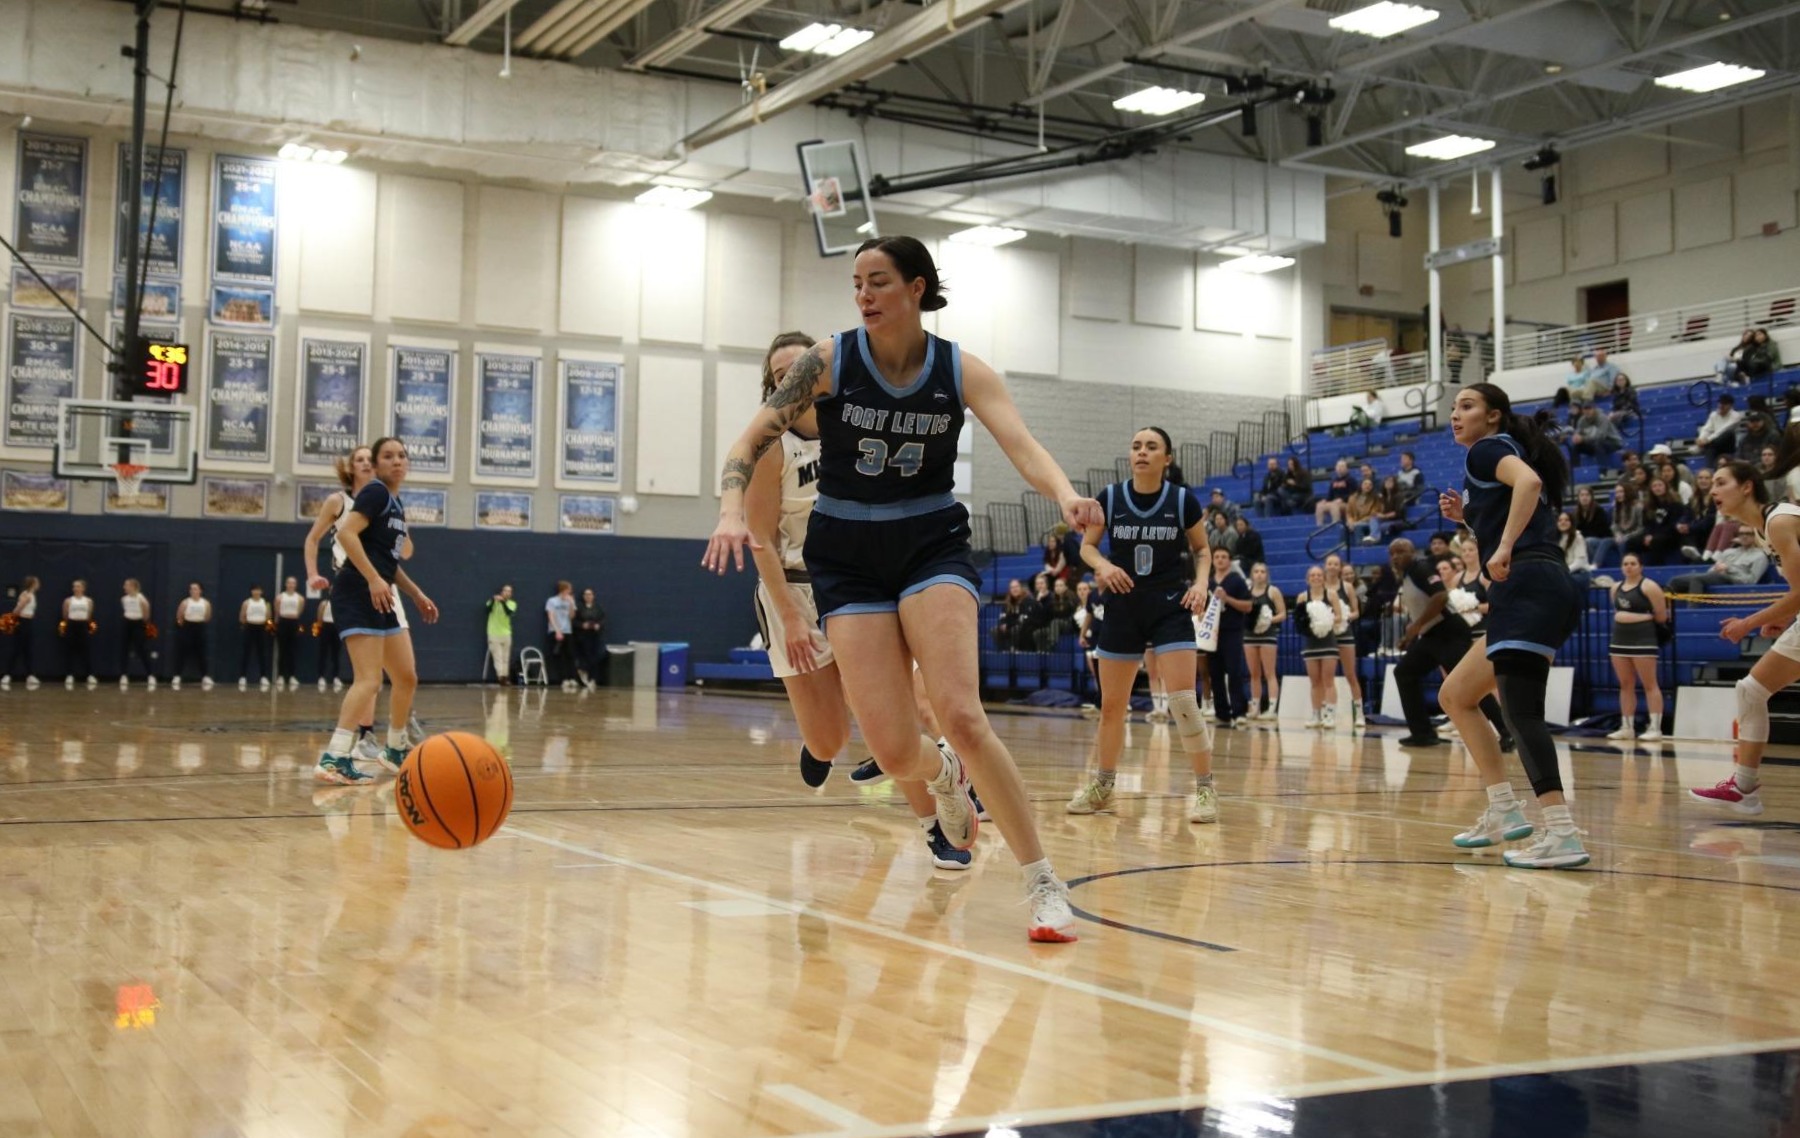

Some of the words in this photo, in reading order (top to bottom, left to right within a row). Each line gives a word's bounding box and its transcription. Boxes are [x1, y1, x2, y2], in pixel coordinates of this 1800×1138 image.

[20, 189, 80, 208] CHAMPIONS
[218, 211, 273, 229] CHAMPIONS
[32, 222, 65, 234] NCAA
[230, 240, 261, 251] NCAA
[217, 340, 266, 352] 2014-2015
[25, 358, 59, 368] RMAC
[12, 365, 72, 380] CHAMPIONS
[146, 361, 180, 390] 30
[224, 380, 256, 391] RMAC
[211, 388, 268, 403] CHAMPIONS
[407, 394, 437, 404] RMAC
[316, 400, 347, 411] RMAC
[395, 402, 447, 416] CHAMPIONS
[222, 420, 254, 430] NCAA
[842, 403, 889, 431] FORT
[891, 411, 951, 435] LEWIS
[315, 423, 347, 433] NCAA
[481, 421, 531, 436] CHAMPIONS
[321, 437, 356, 449] ROUND
[566, 433, 614, 447] CHAMPIONS
[481, 447, 531, 461] TOURNAMENT
[855, 437, 925, 477] 34
[566, 461, 614, 473] TOURNAMENT
[1113, 525, 1140, 540] FORT
[1141, 526, 1179, 540] LEWIS
[1134, 544, 1153, 576] 0
[1200, 595, 1221, 640] MINES
[400, 769, 425, 826] NCAA
